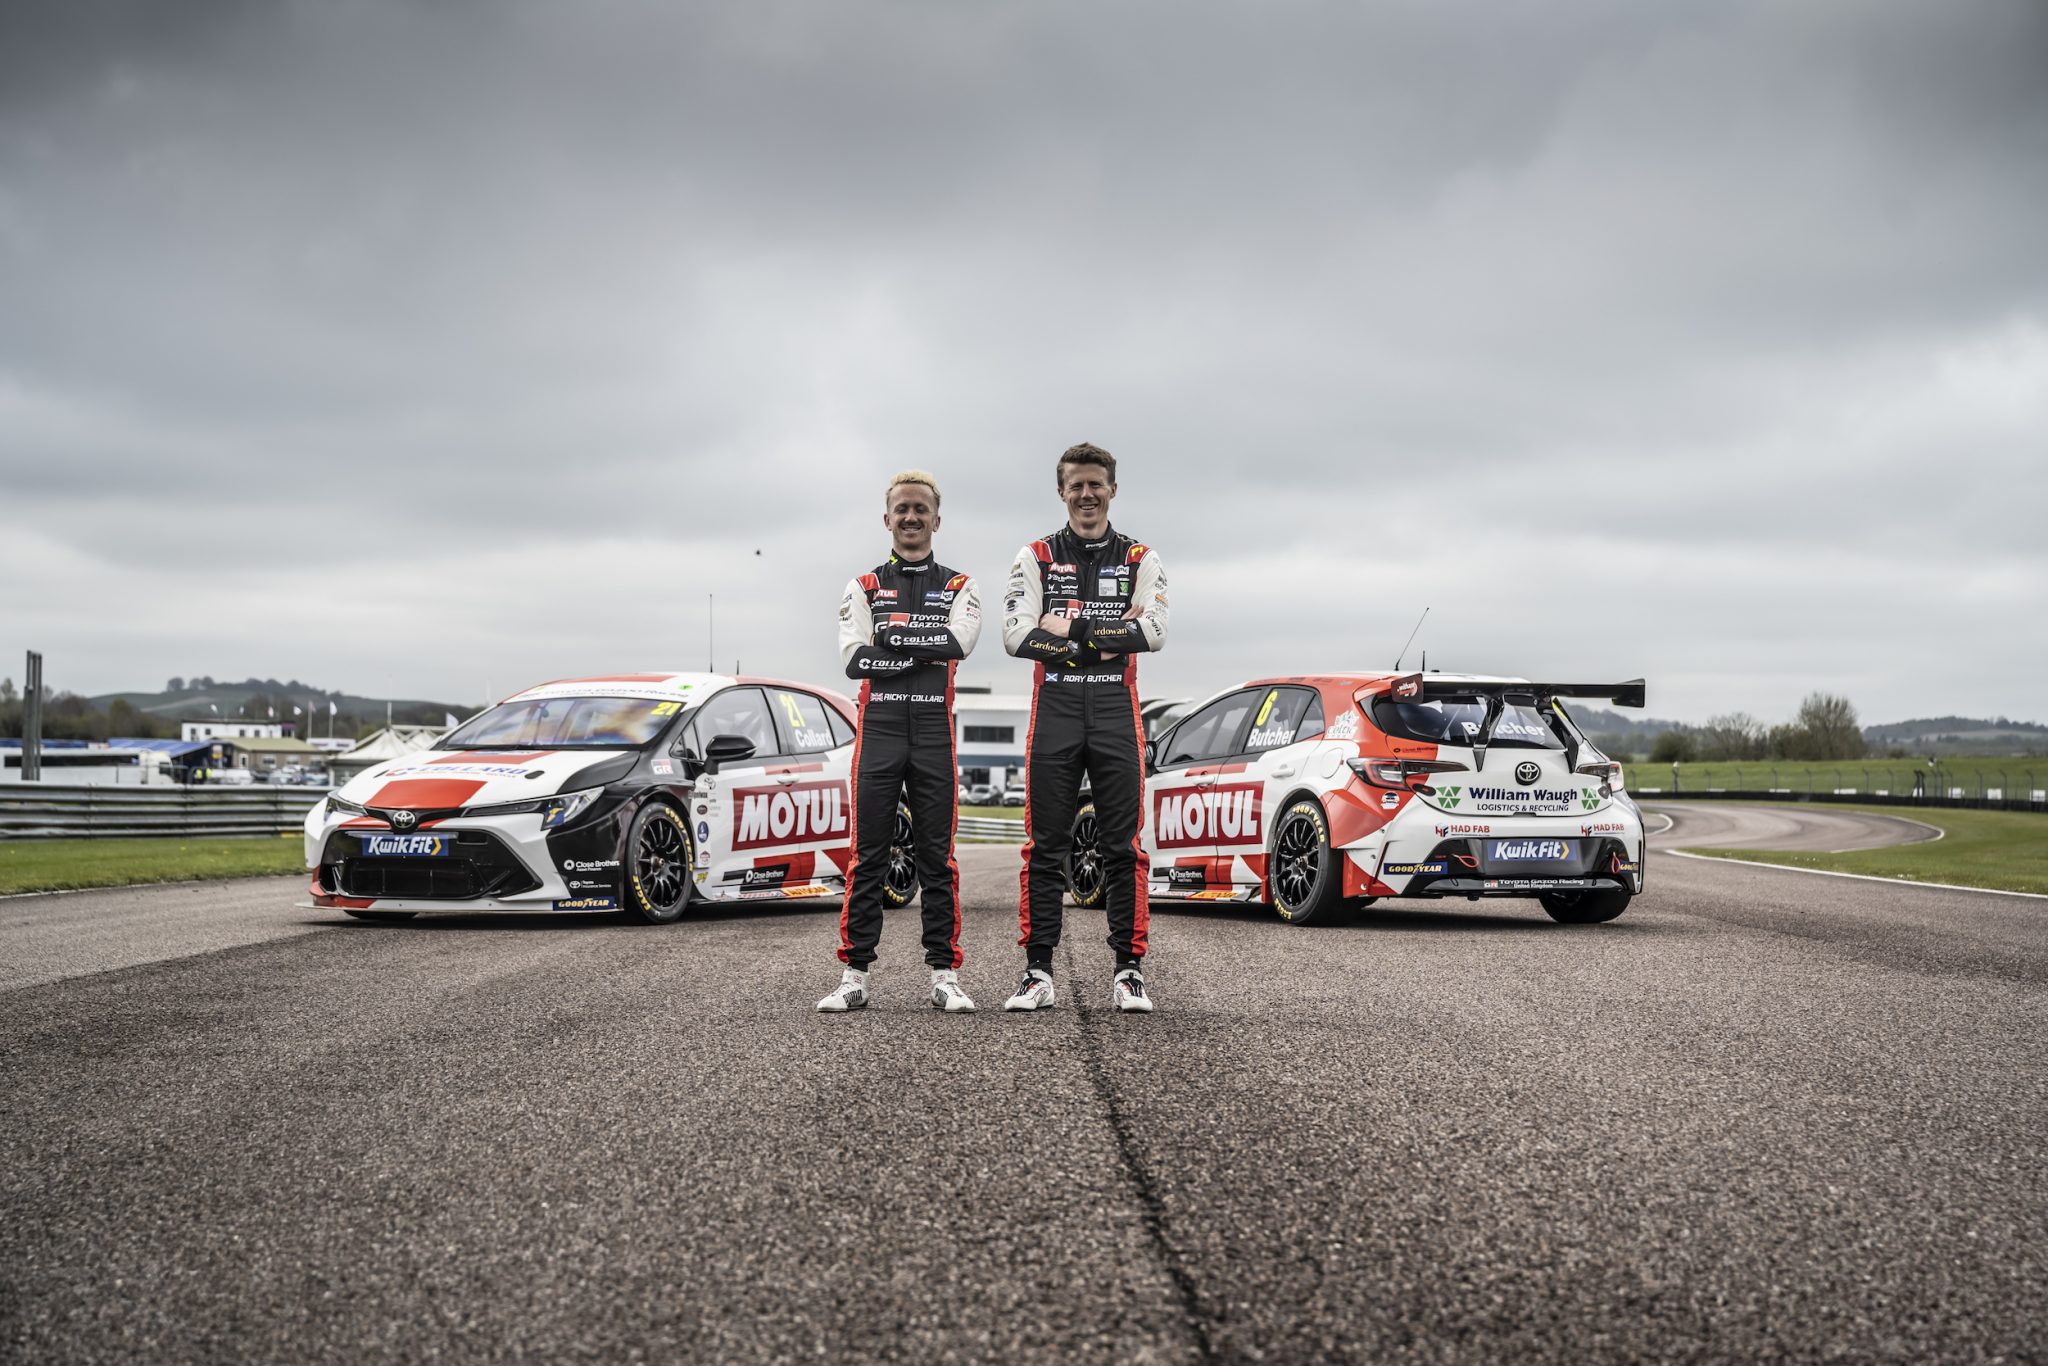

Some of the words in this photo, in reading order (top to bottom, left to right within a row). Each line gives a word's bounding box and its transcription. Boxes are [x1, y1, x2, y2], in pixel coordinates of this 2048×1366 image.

[1084, 601, 1126, 609] TOYOTA
[903, 634, 948, 643] COLLARD
[1029, 639, 1069, 655] Cardowan
[1062, 674, 1087, 683] RORY
[1086, 674, 1123, 683] BUTCHER
[883, 693, 909, 702] RICKY
[910, 694, 945, 703] COLLARD
[651, 702, 683, 716] 21
[779, 694, 806, 727] 21
[1256, 691, 1278, 726] 6
[794, 728, 834, 747] Collard
[1247, 726, 1295, 747] Butcher
[1469, 787, 1530, 801] William
[1533, 788, 1577, 803] Waugh
[737, 788, 847, 842] MOTUL
[1477, 804, 1520, 812] LOGISTICS
[1521, 804, 1528, 812] &
[1529, 804, 1569, 812] RECYCLING
[1158, 789, 1259, 842] MOTUL
[1450, 825, 1471, 833] HAD
[1472, 825, 1490, 833] FAB
[594, 860, 620, 868] Brothers
[765, 870, 785, 879] Brothers
